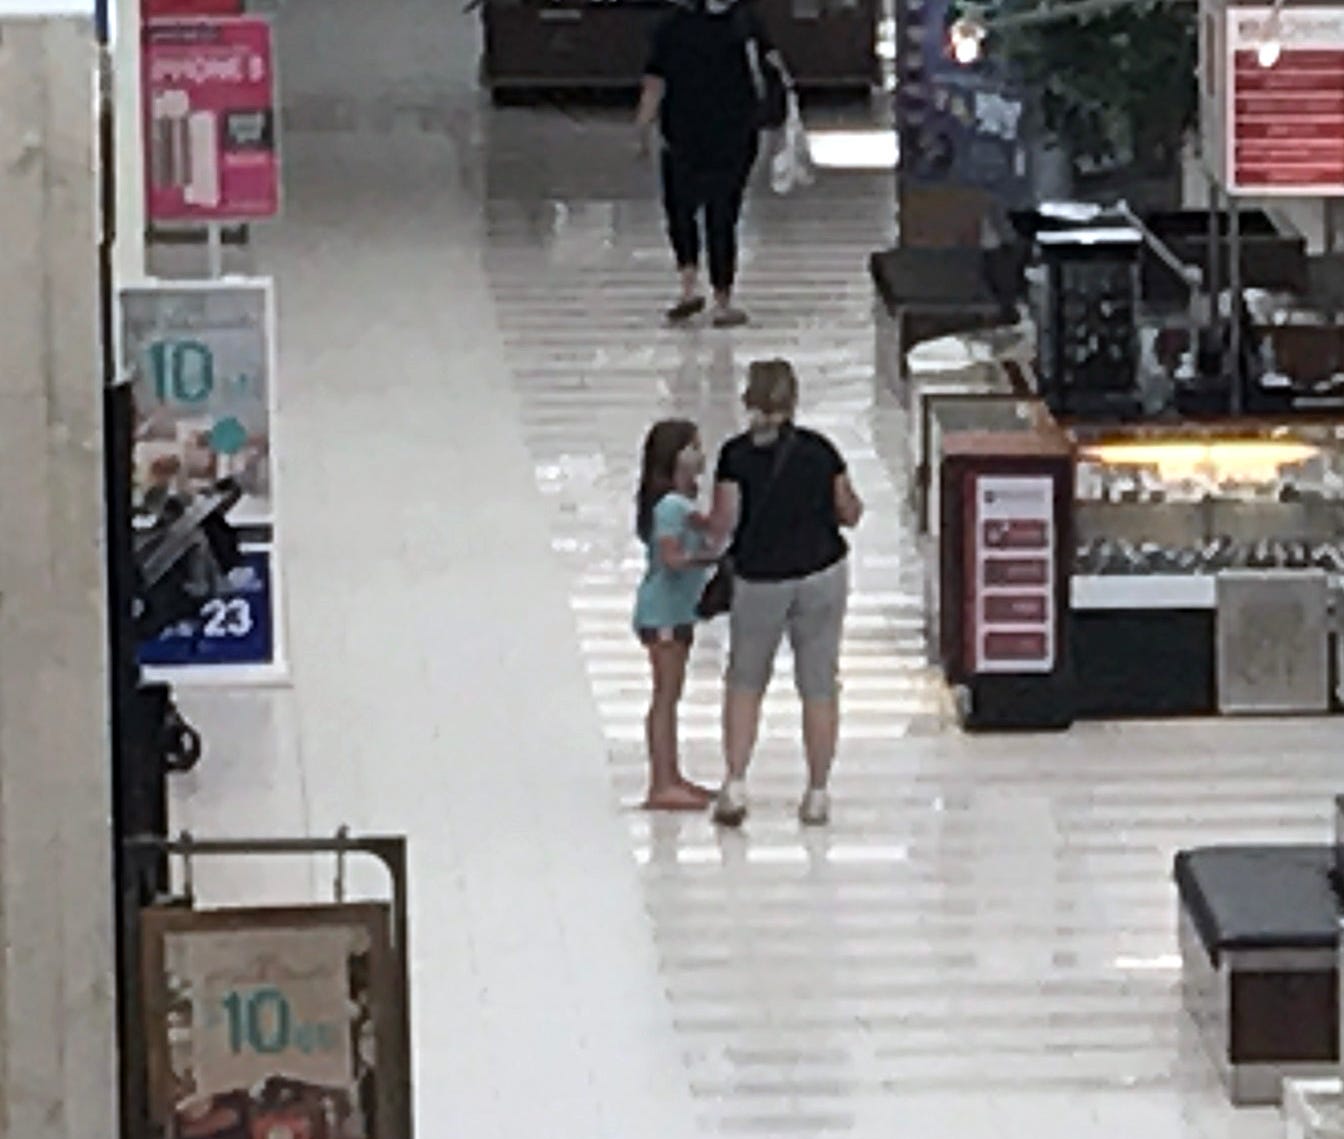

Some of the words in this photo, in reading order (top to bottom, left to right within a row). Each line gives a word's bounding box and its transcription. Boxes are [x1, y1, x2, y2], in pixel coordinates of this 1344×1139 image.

[148, 339, 213, 402] 10
[200, 598, 254, 638] 23
[223, 985, 290, 1056] 10
